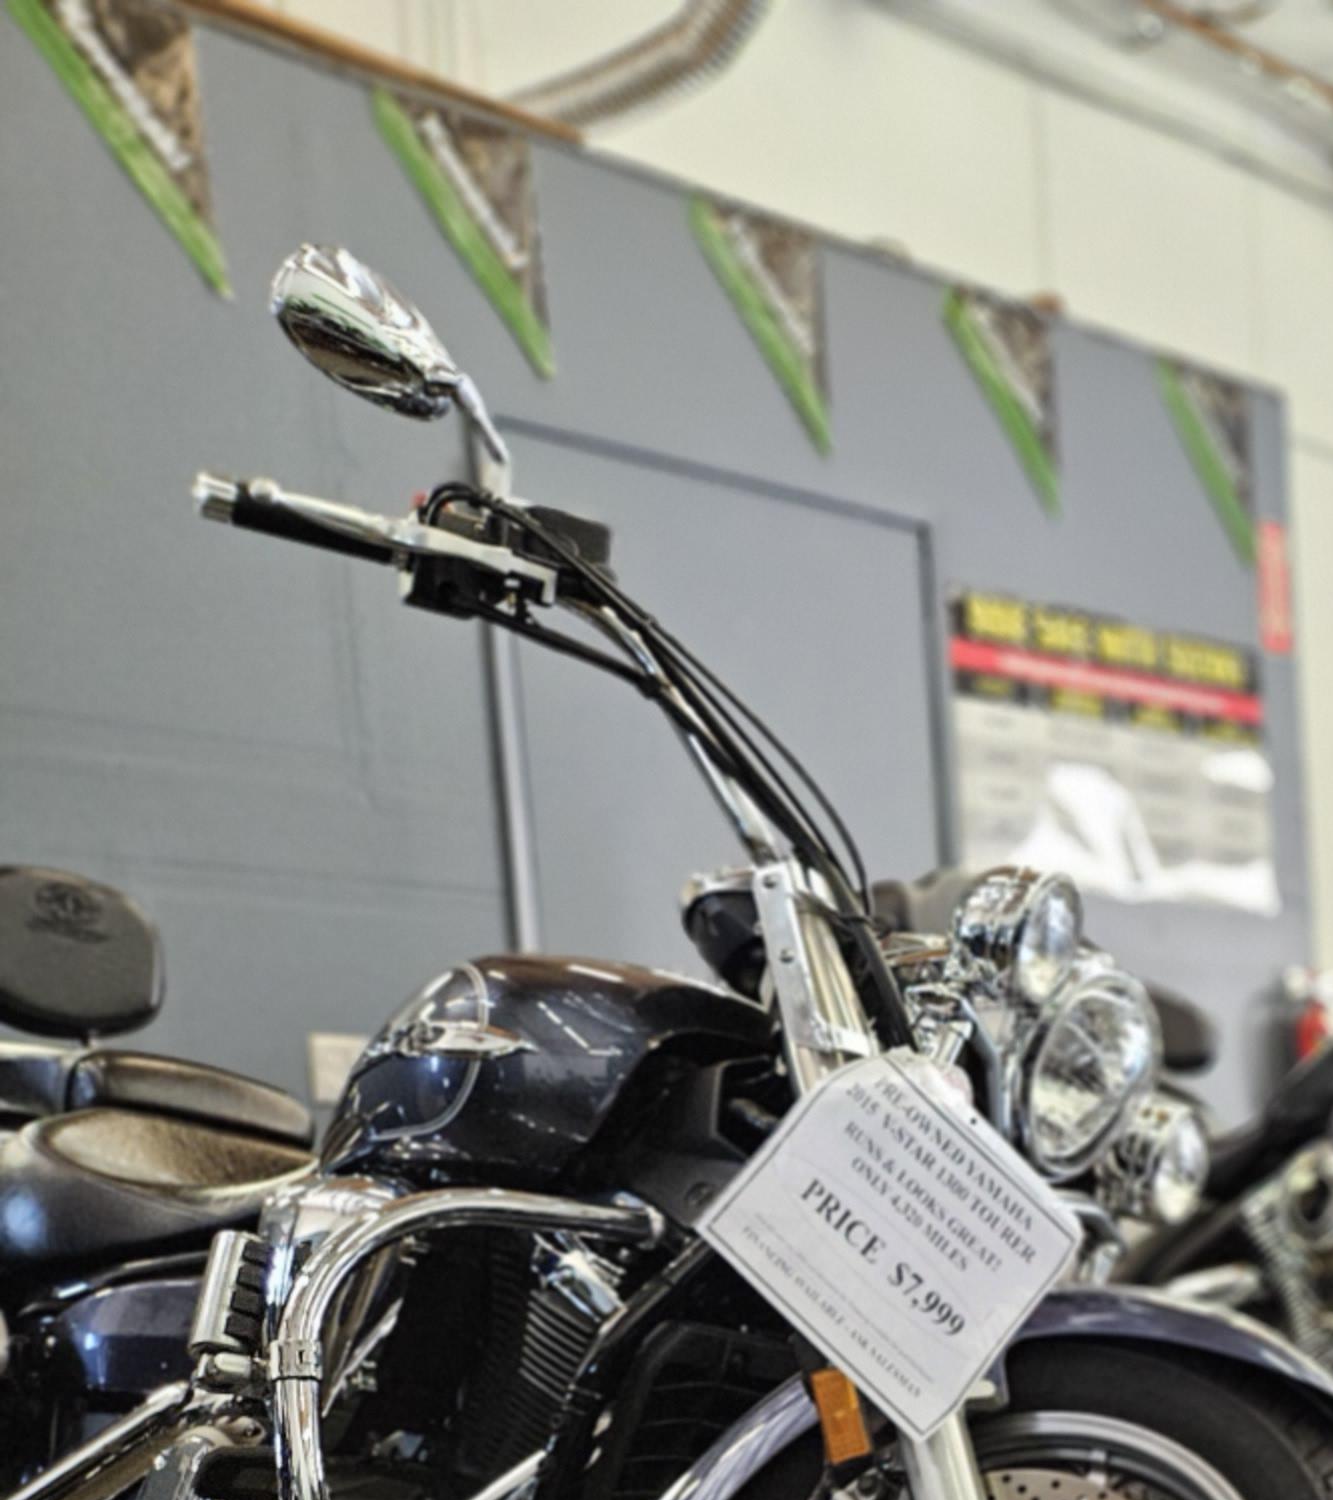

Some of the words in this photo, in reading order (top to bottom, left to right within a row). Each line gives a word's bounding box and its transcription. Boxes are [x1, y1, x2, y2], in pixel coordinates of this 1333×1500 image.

[844, 1082, 880, 1114] 2015
[882, 1112, 936, 1171] V-STAR
[935, 1166, 970, 1201] 1300
[969, 1196, 1036, 1263] TOURER
[844, 1121, 882, 1162] RUNS
[896, 1169, 945, 1221] LOOKS
[946, 1217, 1001, 1270] GREAT!
[851, 1156, 888, 1196] ONLY
[924, 1223, 967, 1270] MILES
[874, 1076, 965, 1165] PRE-OWNED
[966, 1159, 1032, 1230] YAMAHA
[741, 1225, 793, 1277] FINANCING
[800, 1178, 884, 1263] PRICE
[889, 1262, 965, 1335] $7,999
